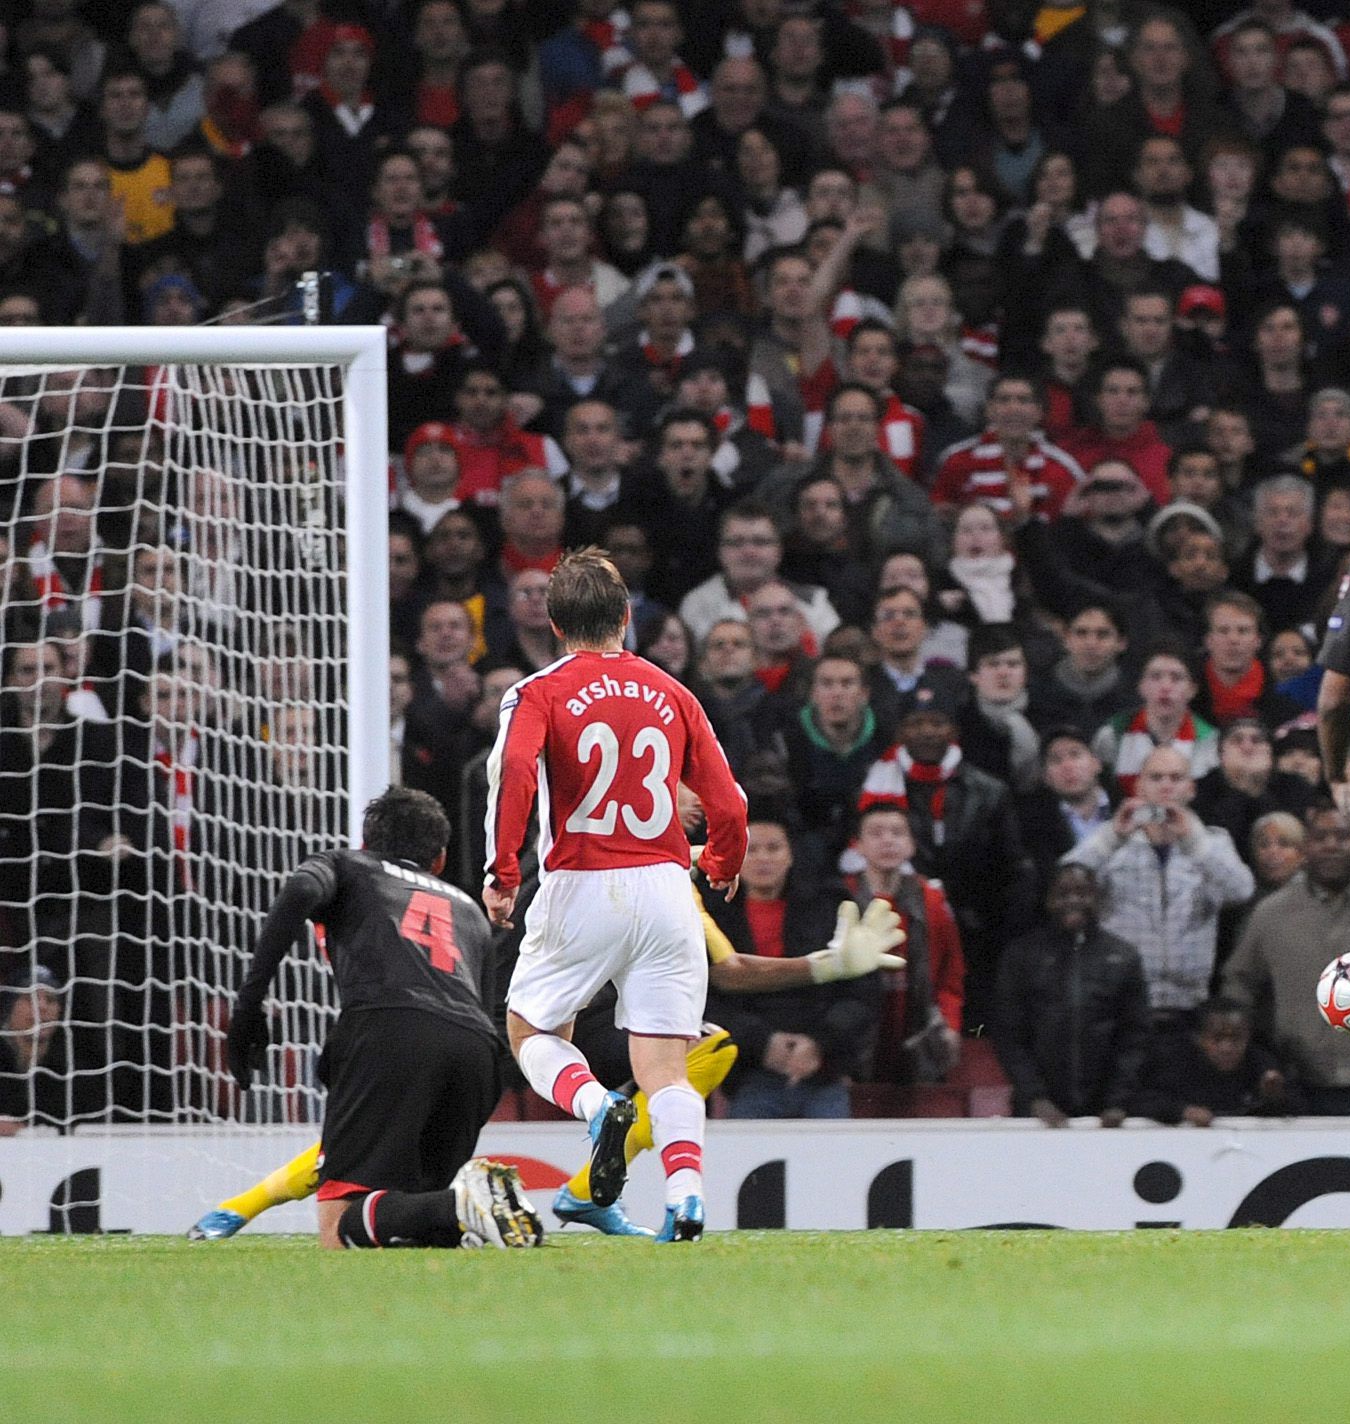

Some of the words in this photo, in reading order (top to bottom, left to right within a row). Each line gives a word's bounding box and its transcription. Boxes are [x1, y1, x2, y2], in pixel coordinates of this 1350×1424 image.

[565, 674, 676, 725] arshavin
[565, 721, 674, 840] 23
[400, 890, 462, 975] 4
